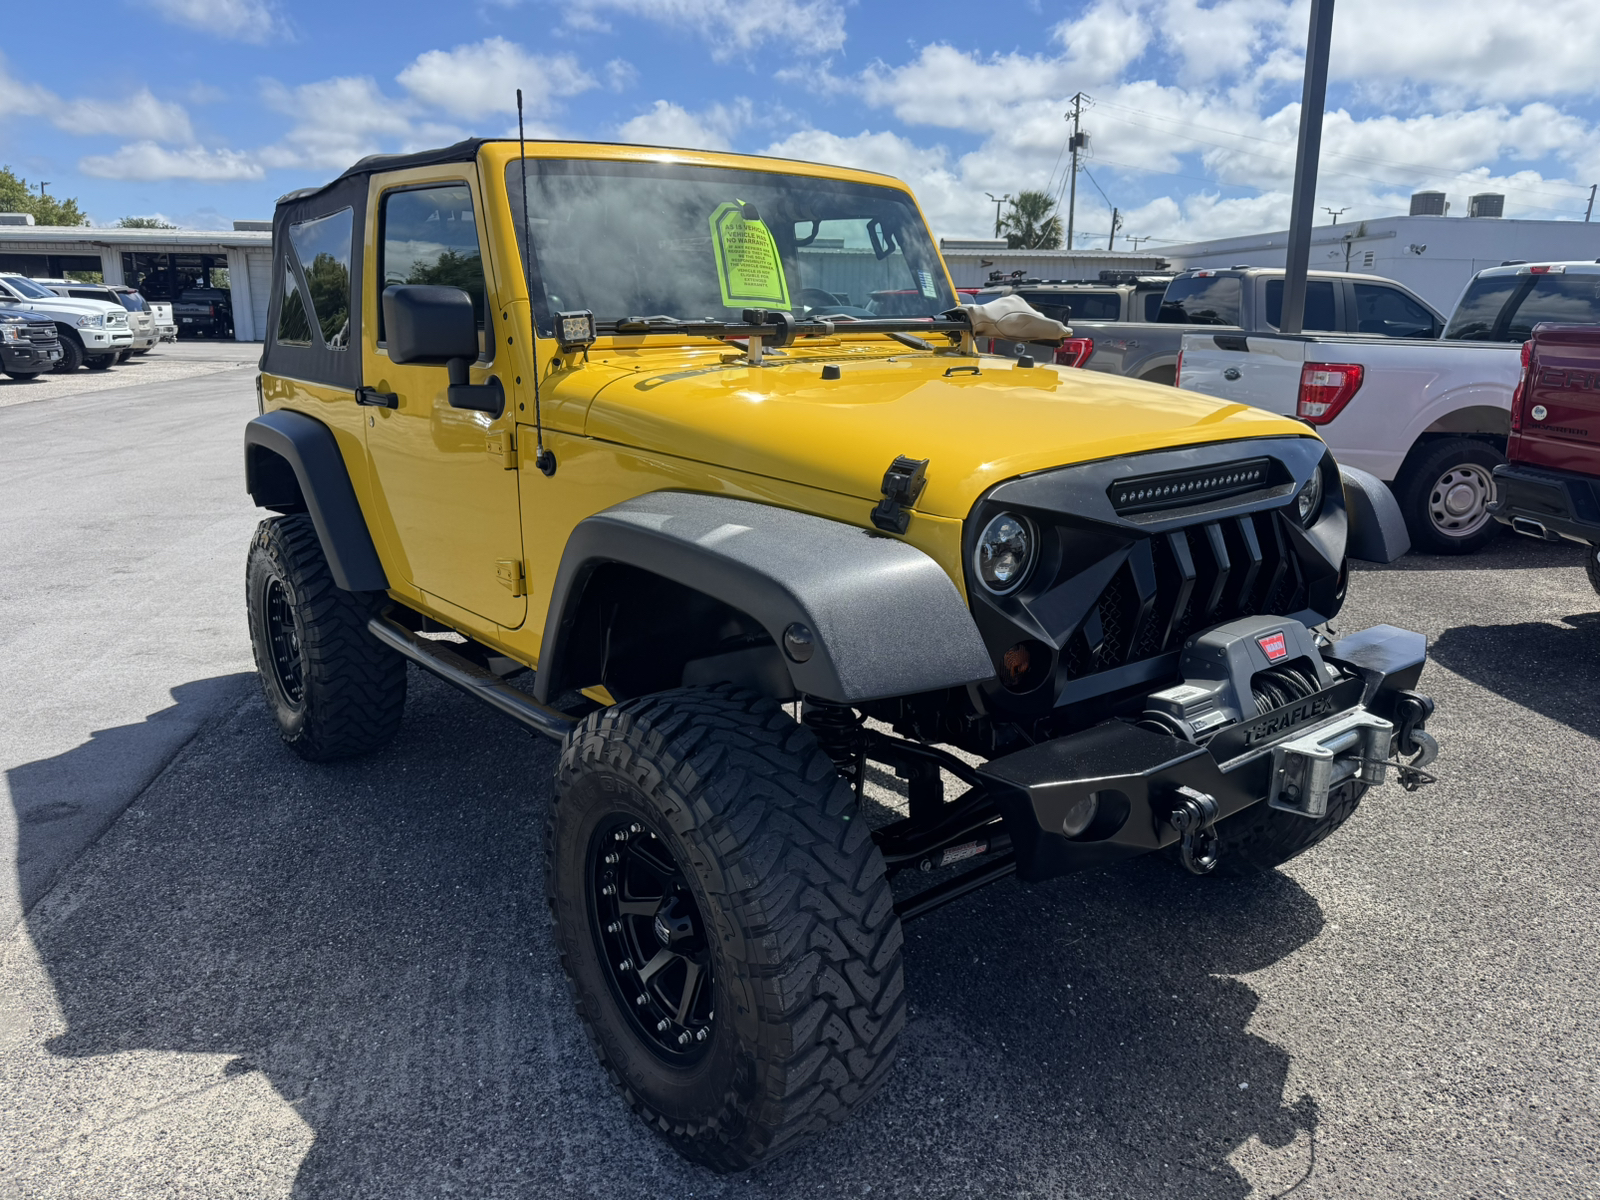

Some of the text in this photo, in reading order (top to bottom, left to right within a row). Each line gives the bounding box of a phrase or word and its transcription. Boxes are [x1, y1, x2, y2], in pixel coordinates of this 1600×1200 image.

[743, 225, 766, 234] VEHICLE
[738, 238, 769, 247] WARRANTY
[1528, 422, 1588, 436] SILVERADO
[1265, 641, 1285, 653] WARN
[1243, 694, 1334, 746] TERAFLEX
